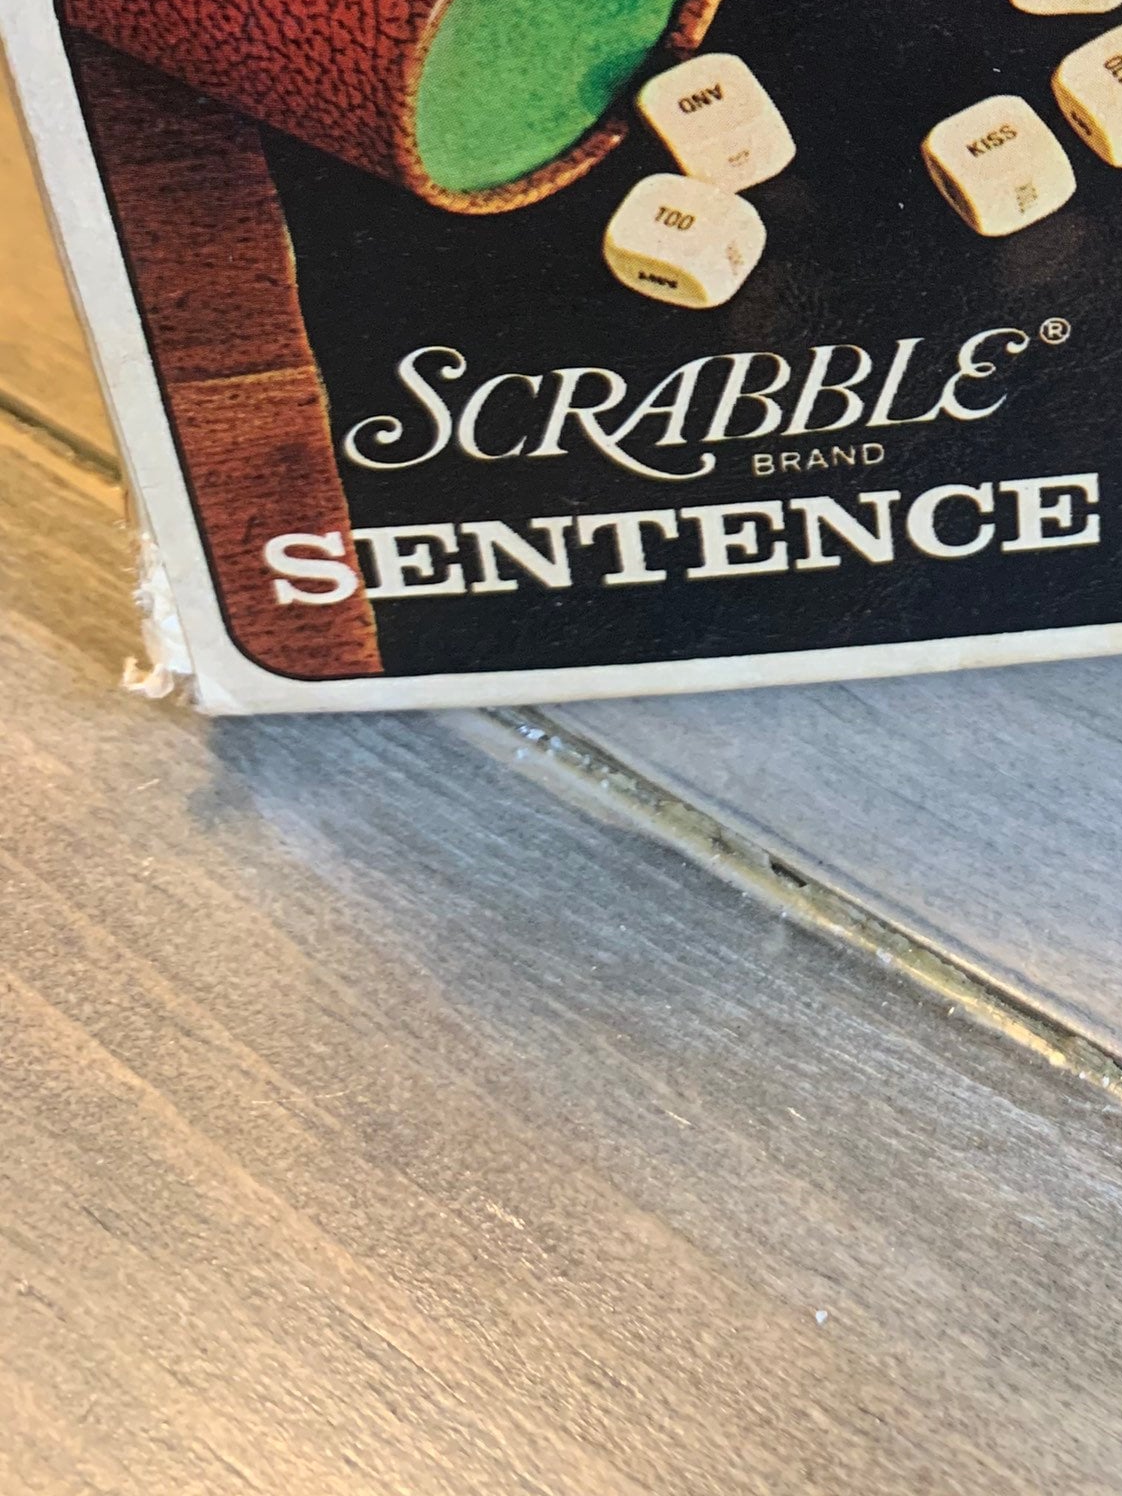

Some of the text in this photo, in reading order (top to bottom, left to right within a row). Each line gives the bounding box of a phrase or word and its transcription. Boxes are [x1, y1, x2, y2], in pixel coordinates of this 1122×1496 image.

[678, 82, 724, 115] AND
[966, 123, 1018, 158] KISS
[654, 206, 697, 232] TOO
[752, 442, 885, 476] BRAND
[265, 472, 1100, 607] SENTENCE
